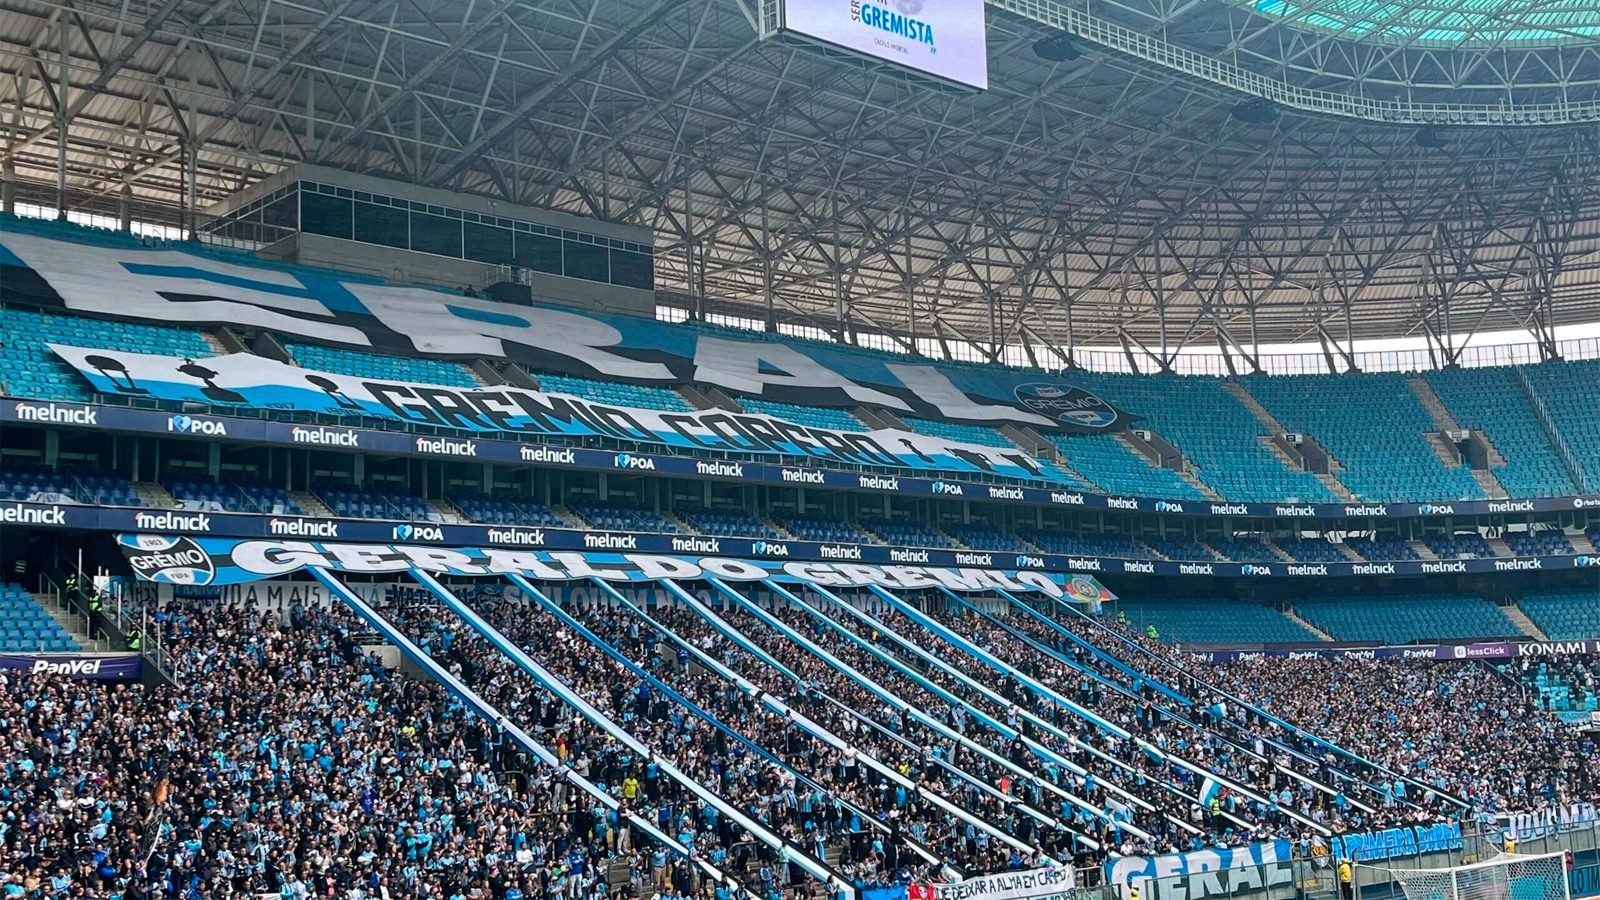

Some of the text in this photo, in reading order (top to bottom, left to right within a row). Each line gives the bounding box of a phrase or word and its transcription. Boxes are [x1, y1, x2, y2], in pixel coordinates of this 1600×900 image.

[861, 4, 934, 46] GREMISTA
[14, 401, 98, 425] melnick
[190, 418, 227, 436] POA
[291, 424, 361, 447] melnick
[659, 413, 912, 467] COPERO
[415, 437, 477, 457] melnick
[519, 443, 578, 464] melnick
[629, 456, 656, 470] POA
[696, 459, 744, 477] melnick
[781, 466, 827, 484] melnick
[858, 473, 901, 491] melnick
[943, 483, 963, 496] POA
[988, 485, 1024, 500] melnick
[1050, 491, 1085, 505] melnick
[1107, 496, 1139, 510] melnick
[1487, 498, 1535, 513] melnick
[0, 504, 66, 525] elnick
[1165, 502, 1184, 513] POA
[1210, 503, 1248, 515] melnick
[1275, 504, 1316, 517] melnick
[1344, 504, 1387, 516] melnick
[1432, 505, 1455, 515] POA
[135, 509, 213, 531] melnick
[269, 516, 341, 537] melnick
[414, 528, 444, 541] POA
[487, 526, 547, 545] melnick
[583, 531, 639, 549] melnick
[671, 535, 722, 553] melnick
[767, 543, 789, 556] POA
[130, 549, 204, 570] GRÊMIO
[819, 544, 862, 560] melnick
[889, 547, 931, 563] melnick
[955, 552, 992, 566] melnick
[231, 540, 630, 579] GERAL
[622, 553, 770, 580] DO
[1027, 557, 1045, 568] POA
[1068, 557, 1101, 571] melnick
[1123, 560, 1155, 574] melnick
[1419, 558, 1467, 573] melnick
[1492, 556, 1542, 571] melnick
[1179, 562, 1214, 575] melnick
[1252, 566, 1272, 576] POA
[1285, 561, 1330, 576] melnick
[1350, 561, 1396, 575] melnick
[1518, 641, 1587, 656] KONAMI
[33, 659, 101, 675] PanVel
[1111, 841, 1293, 900] GERAL
[953, 880, 988, 899] DEIXAR
[989, 880, 997, 893] A
[999, 876, 1023, 892] ALMA
[1024, 874, 1036, 889] EM
